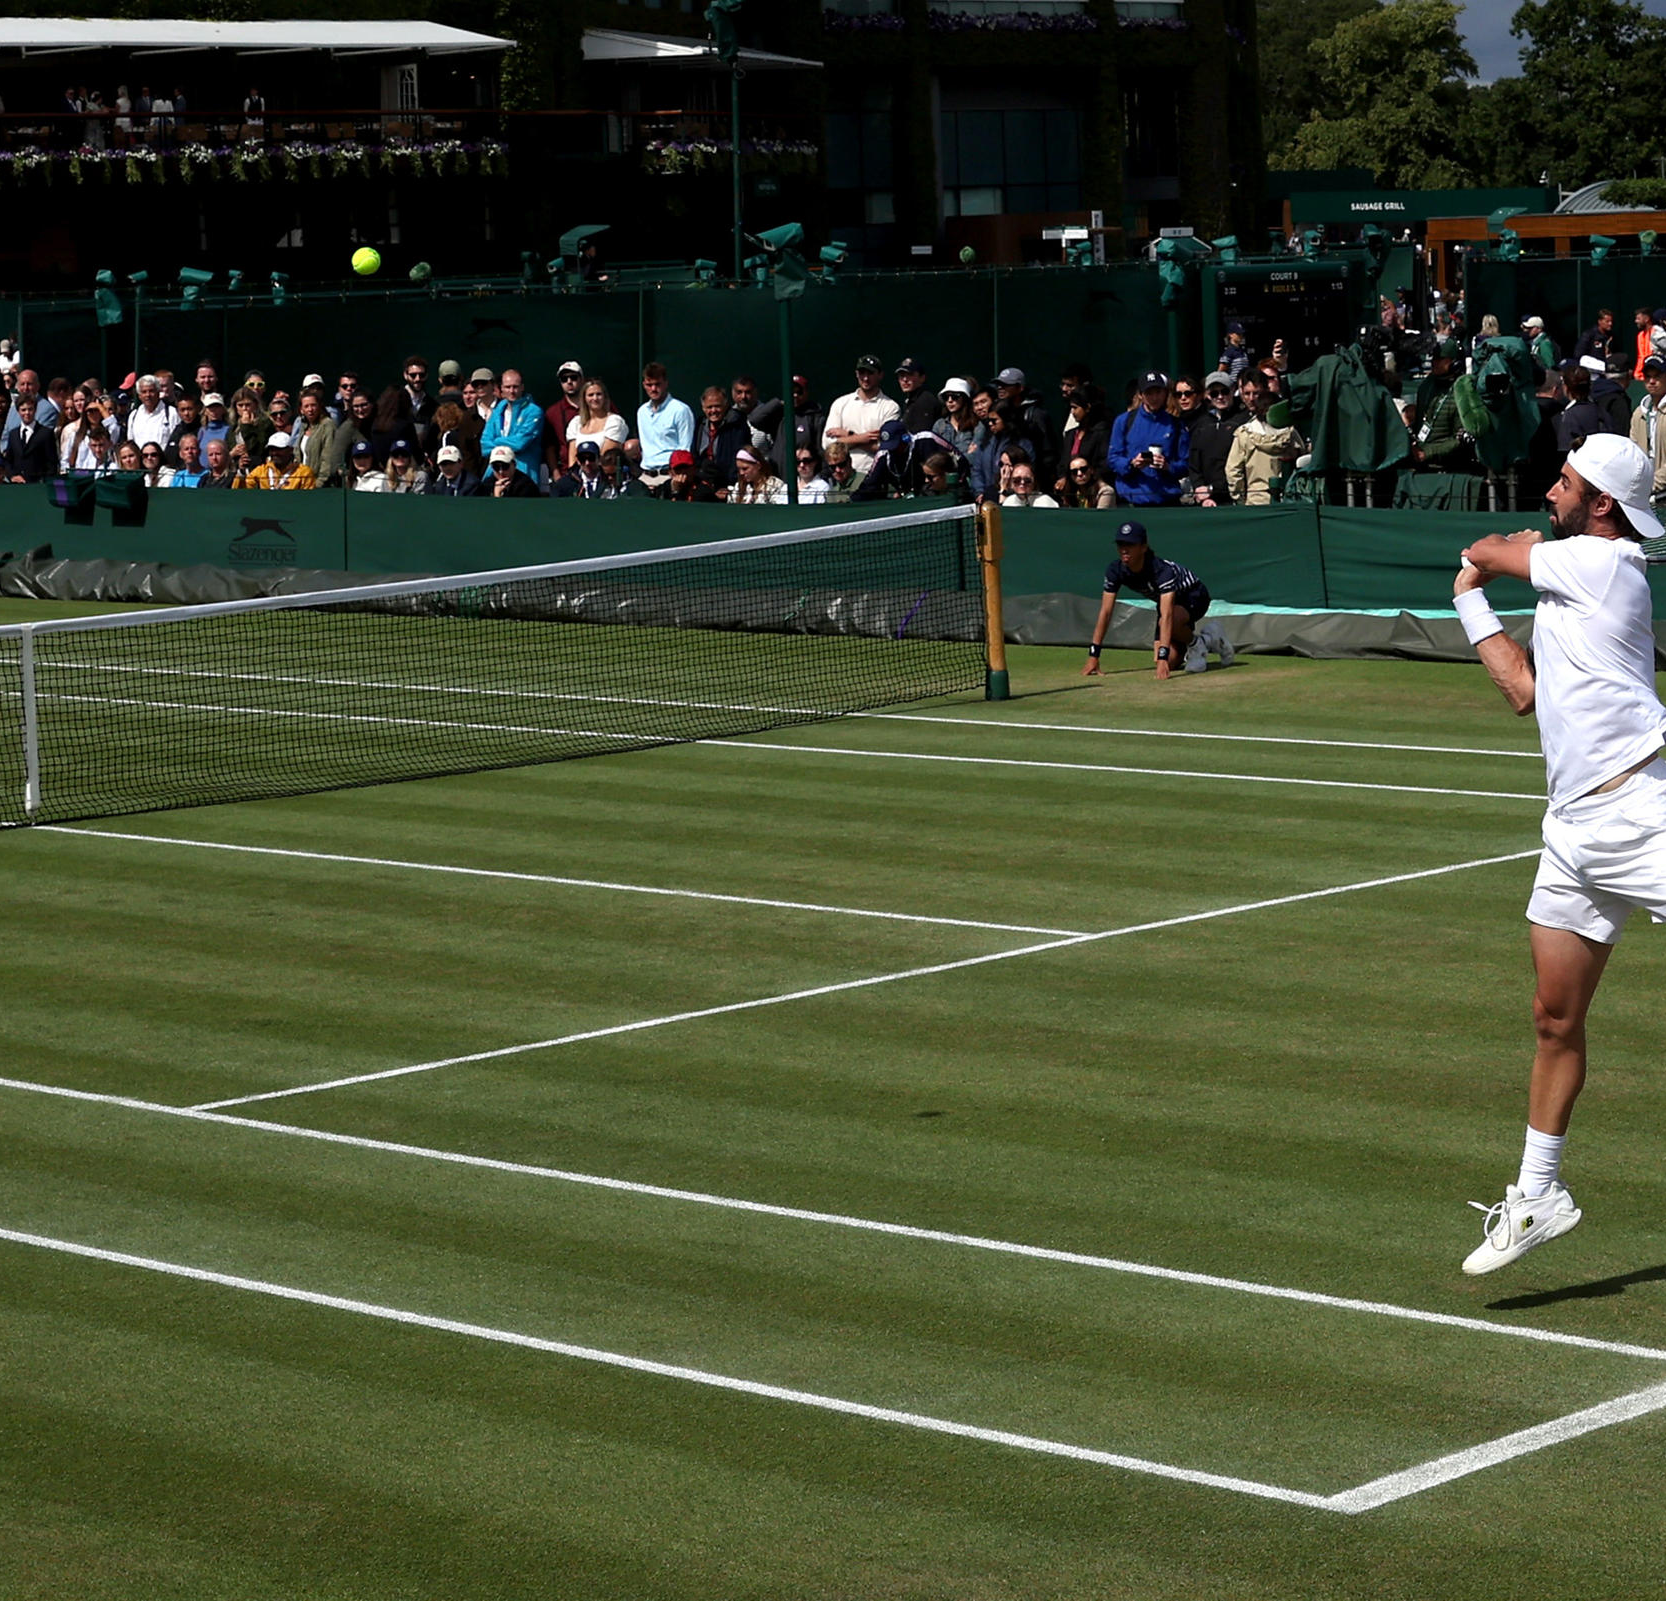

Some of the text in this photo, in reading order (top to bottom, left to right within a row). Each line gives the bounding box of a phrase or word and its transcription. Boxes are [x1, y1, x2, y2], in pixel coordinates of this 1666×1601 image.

[1350, 201, 1405, 211] SAUSAGE GRILL
[1270, 272, 1292, 281] COURT
[229, 543, 297, 565] Slazenger
